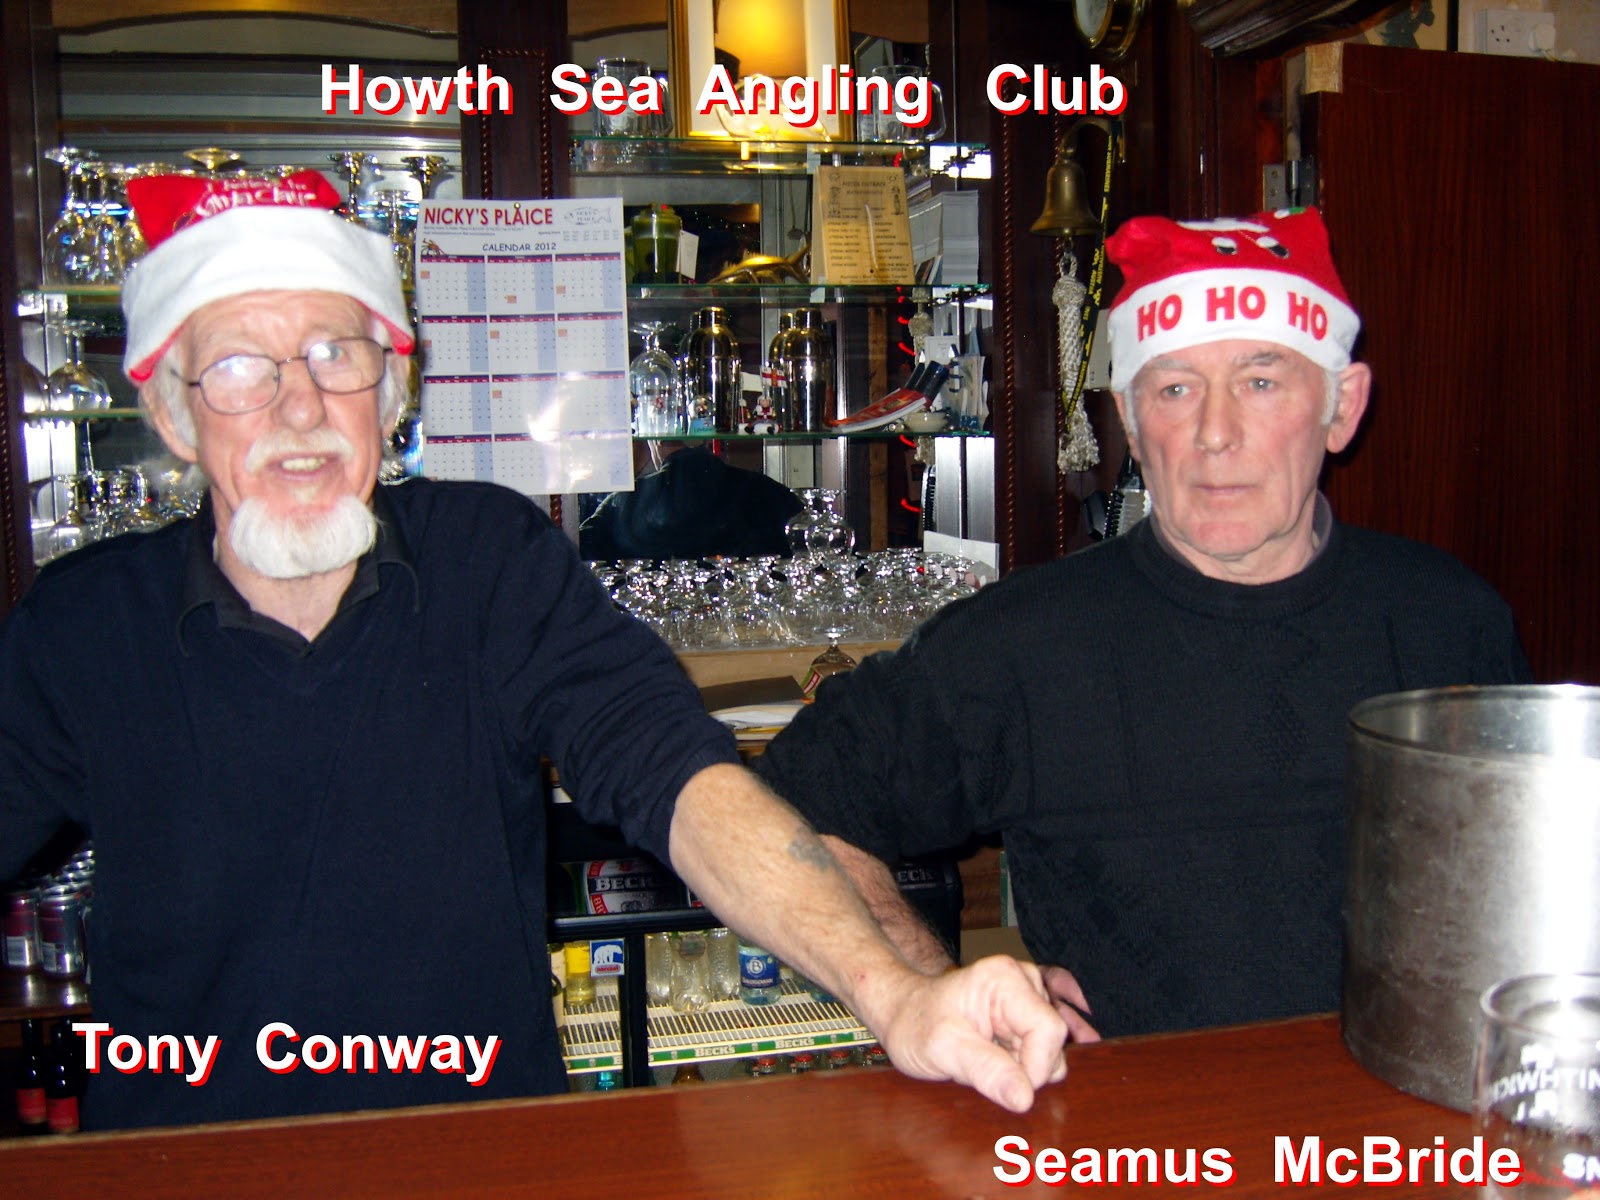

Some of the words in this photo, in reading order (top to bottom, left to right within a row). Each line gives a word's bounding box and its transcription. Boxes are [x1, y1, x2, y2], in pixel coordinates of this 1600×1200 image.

[424, 207, 489, 225] NICKY'S
[494, 208, 553, 226] PLAICE
[482, 243, 531, 252] CALENDAR
[535, 242, 557, 251] 2012
[1136, 293, 1183, 342] HO
[1206, 285, 1266, 322] HO
[1288, 291, 1328, 341] HO
